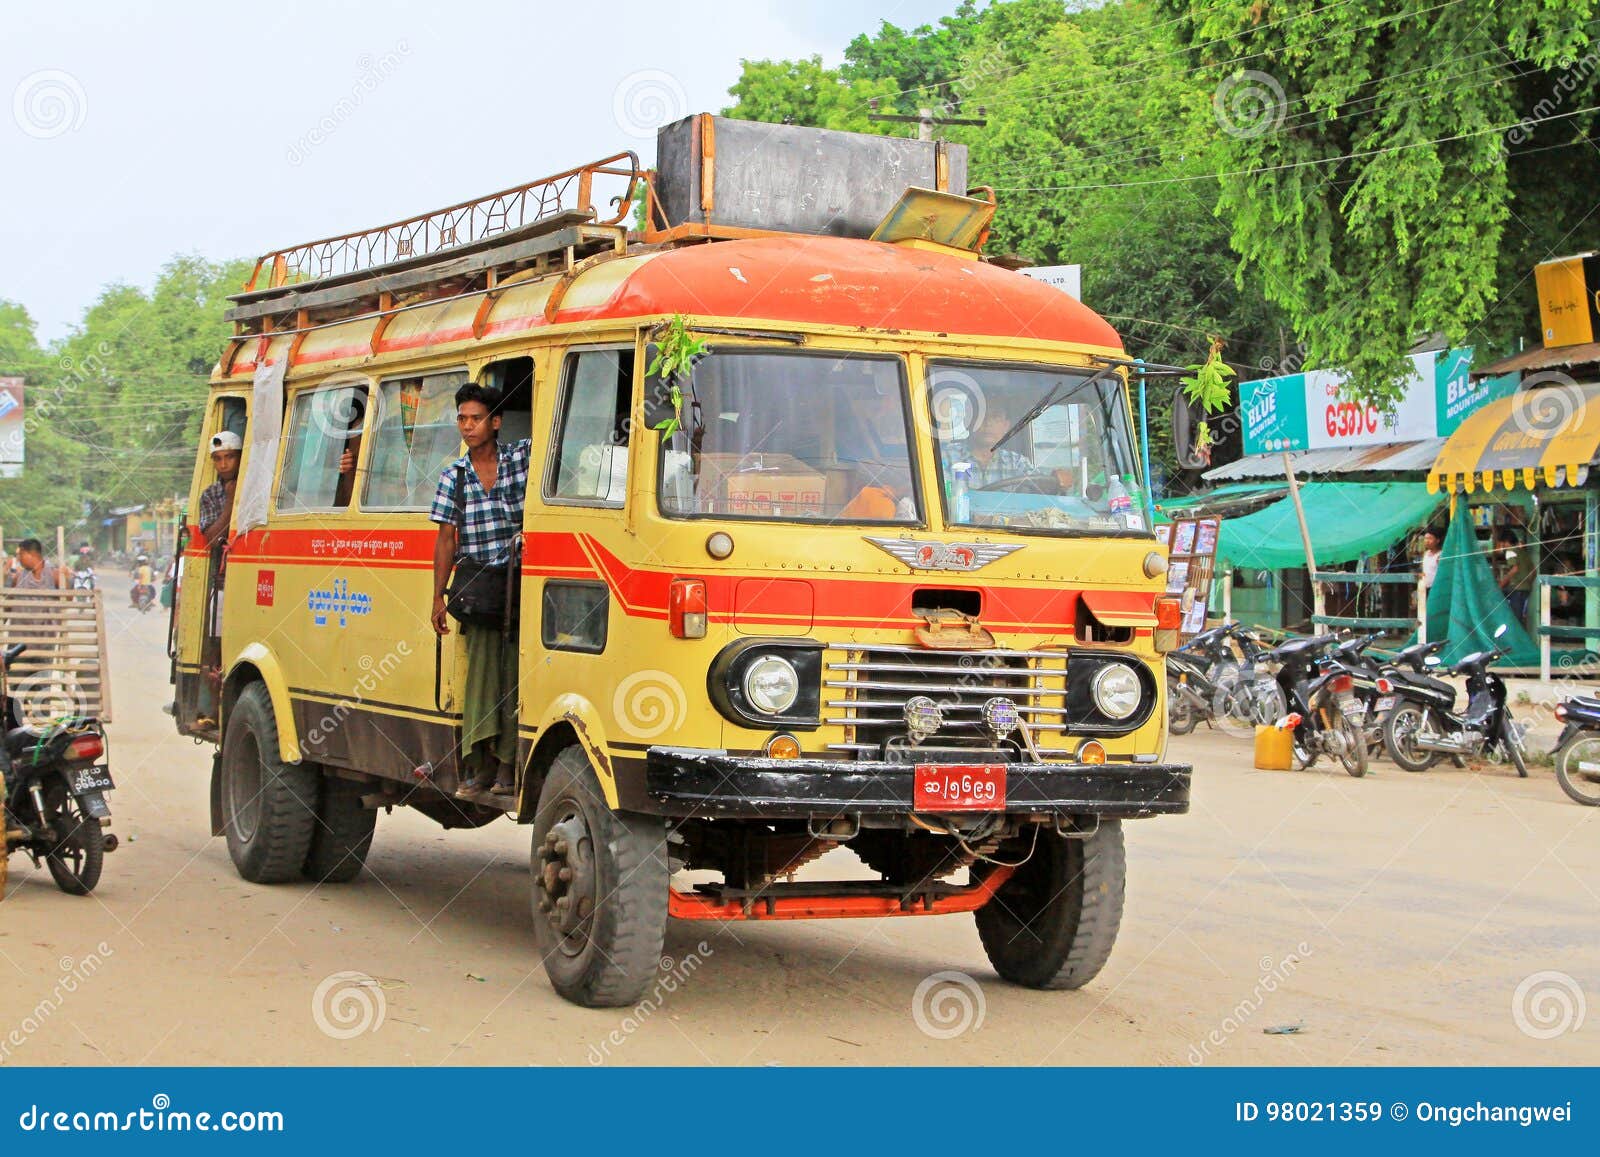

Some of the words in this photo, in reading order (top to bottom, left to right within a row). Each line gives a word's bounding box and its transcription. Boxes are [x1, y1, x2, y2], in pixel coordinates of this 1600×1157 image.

[1447, 374, 1488, 405] BLU
[1447, 385, 1489, 419] MOUNTAIN
[1249, 392, 1276, 428] BLUE
[1326, 400, 1378, 437] အောင
